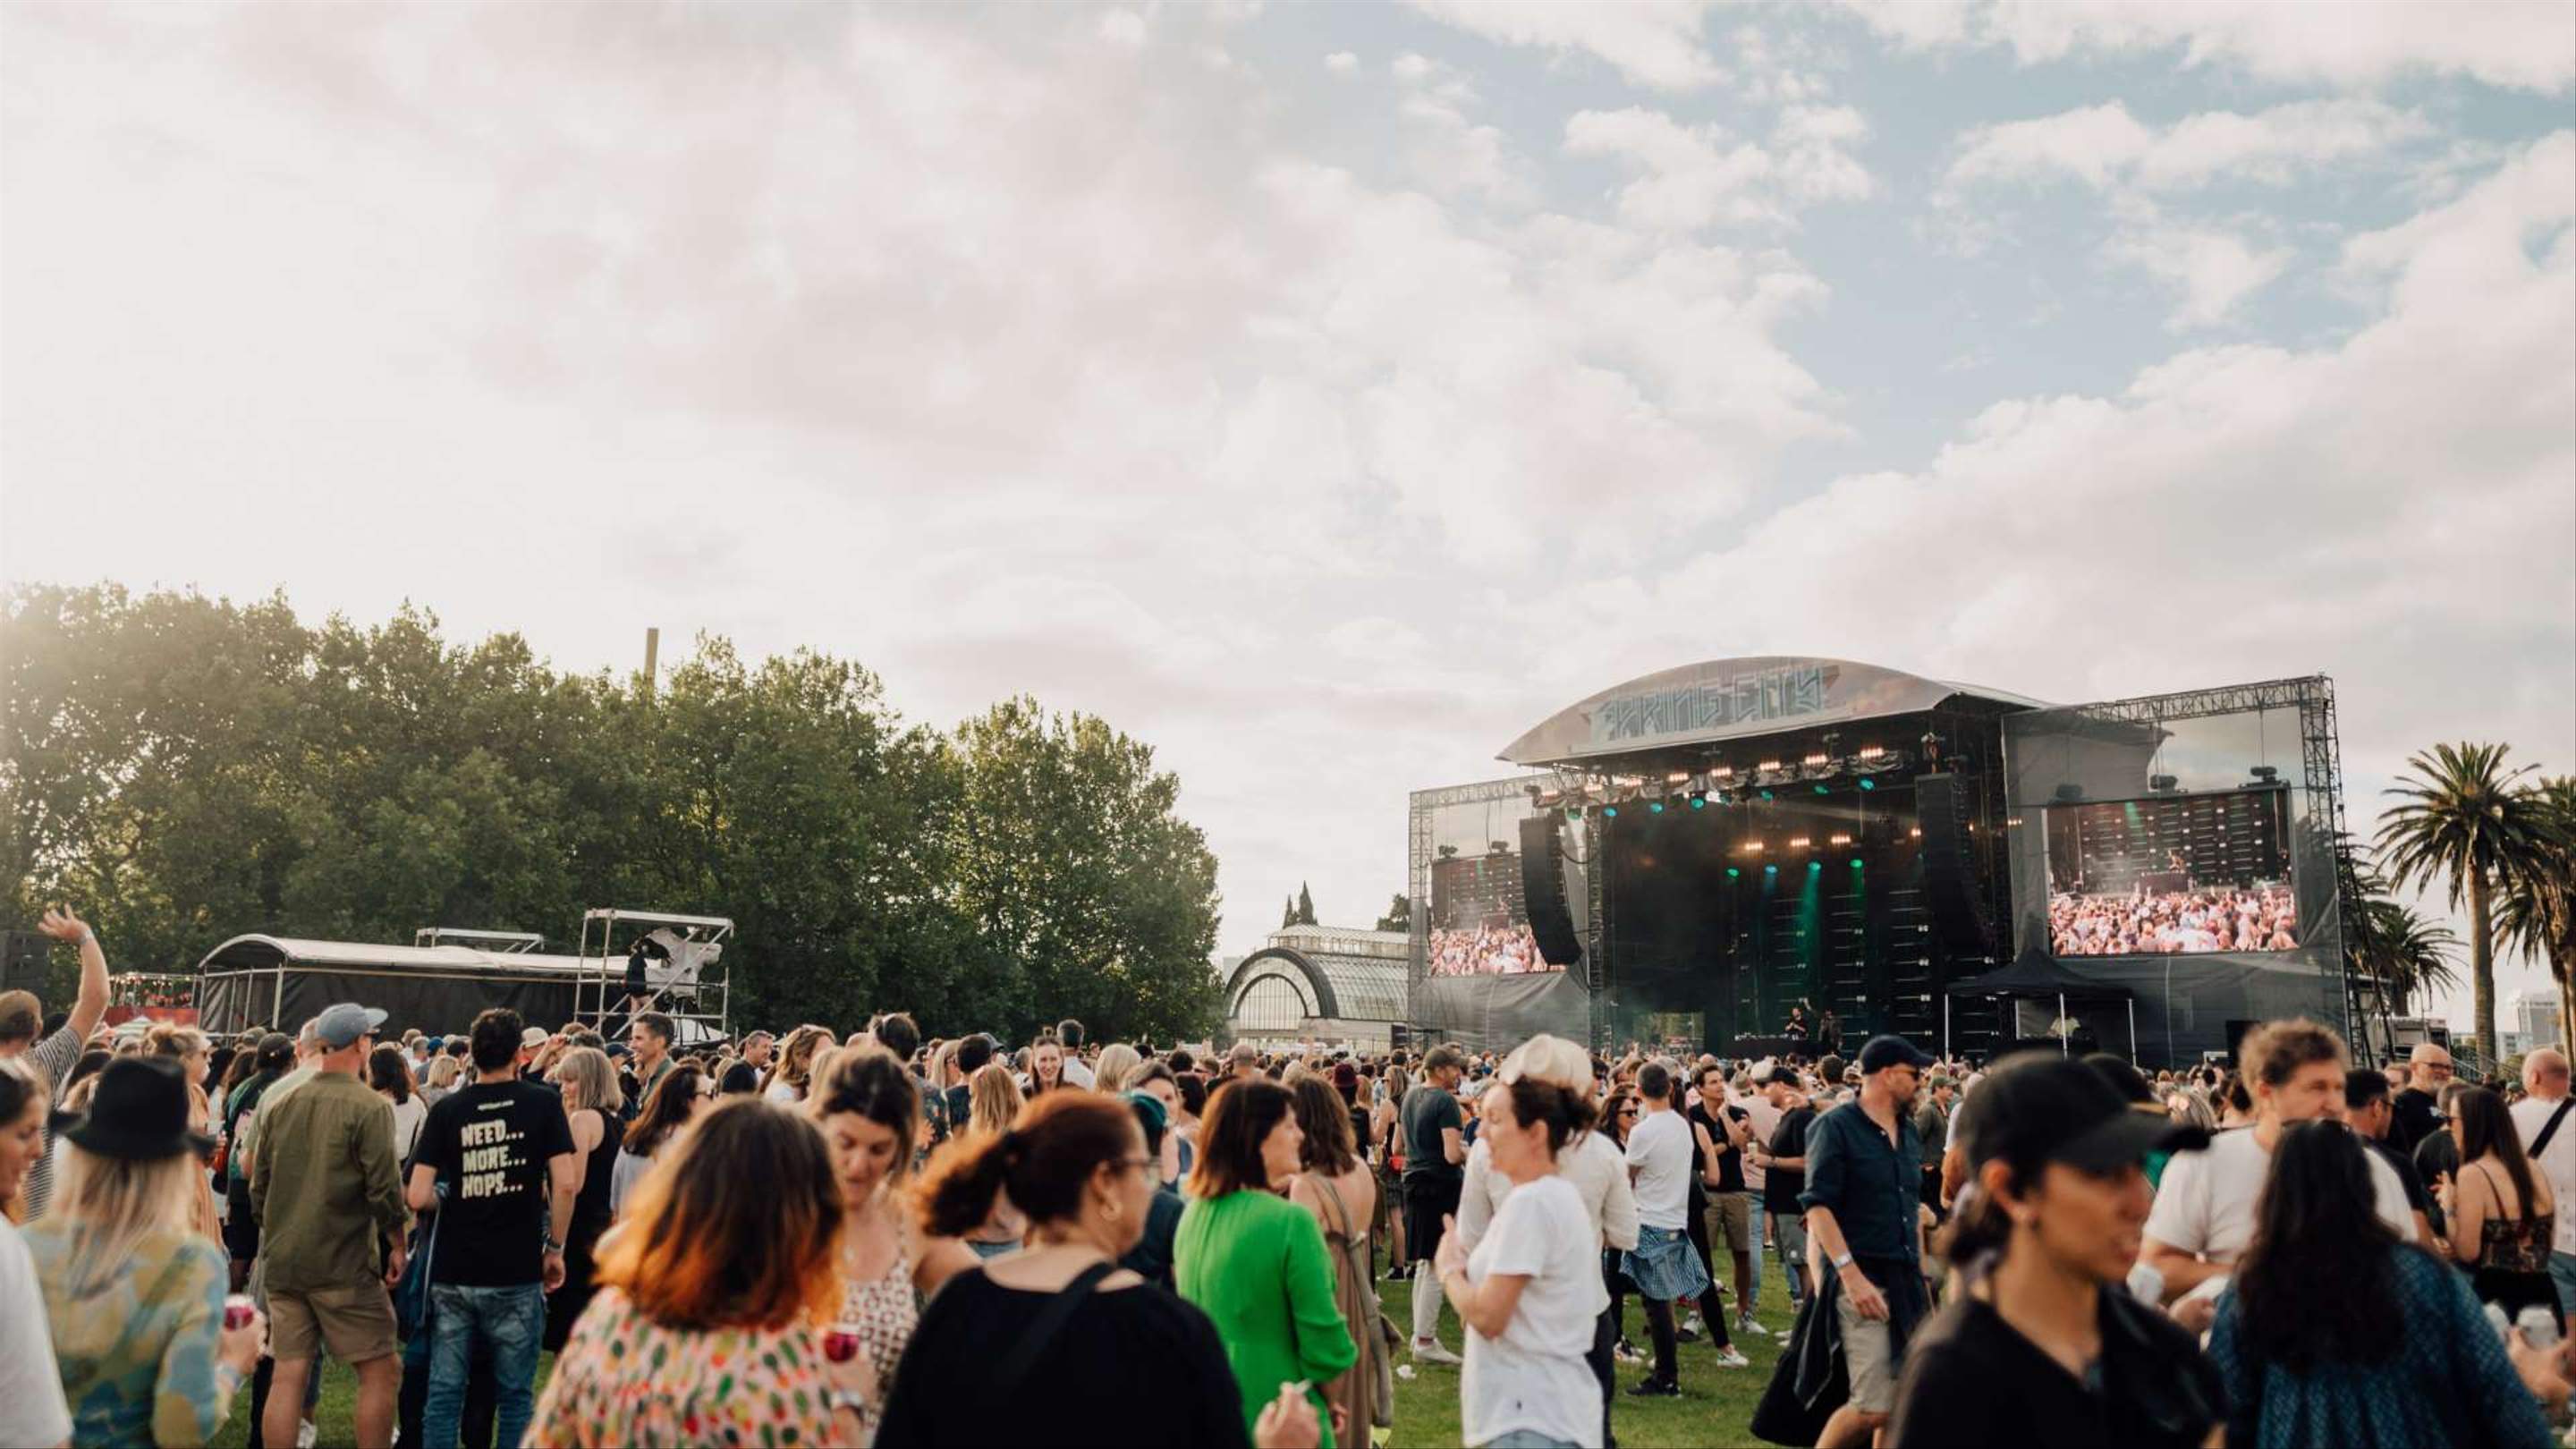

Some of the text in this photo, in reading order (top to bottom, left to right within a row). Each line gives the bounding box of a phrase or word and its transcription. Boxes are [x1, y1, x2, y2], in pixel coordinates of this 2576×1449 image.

[462, 1119, 524, 1147] NEED...
[463, 1146, 526, 1172] MORE...
[462, 1171, 522, 1199] HOPS...
